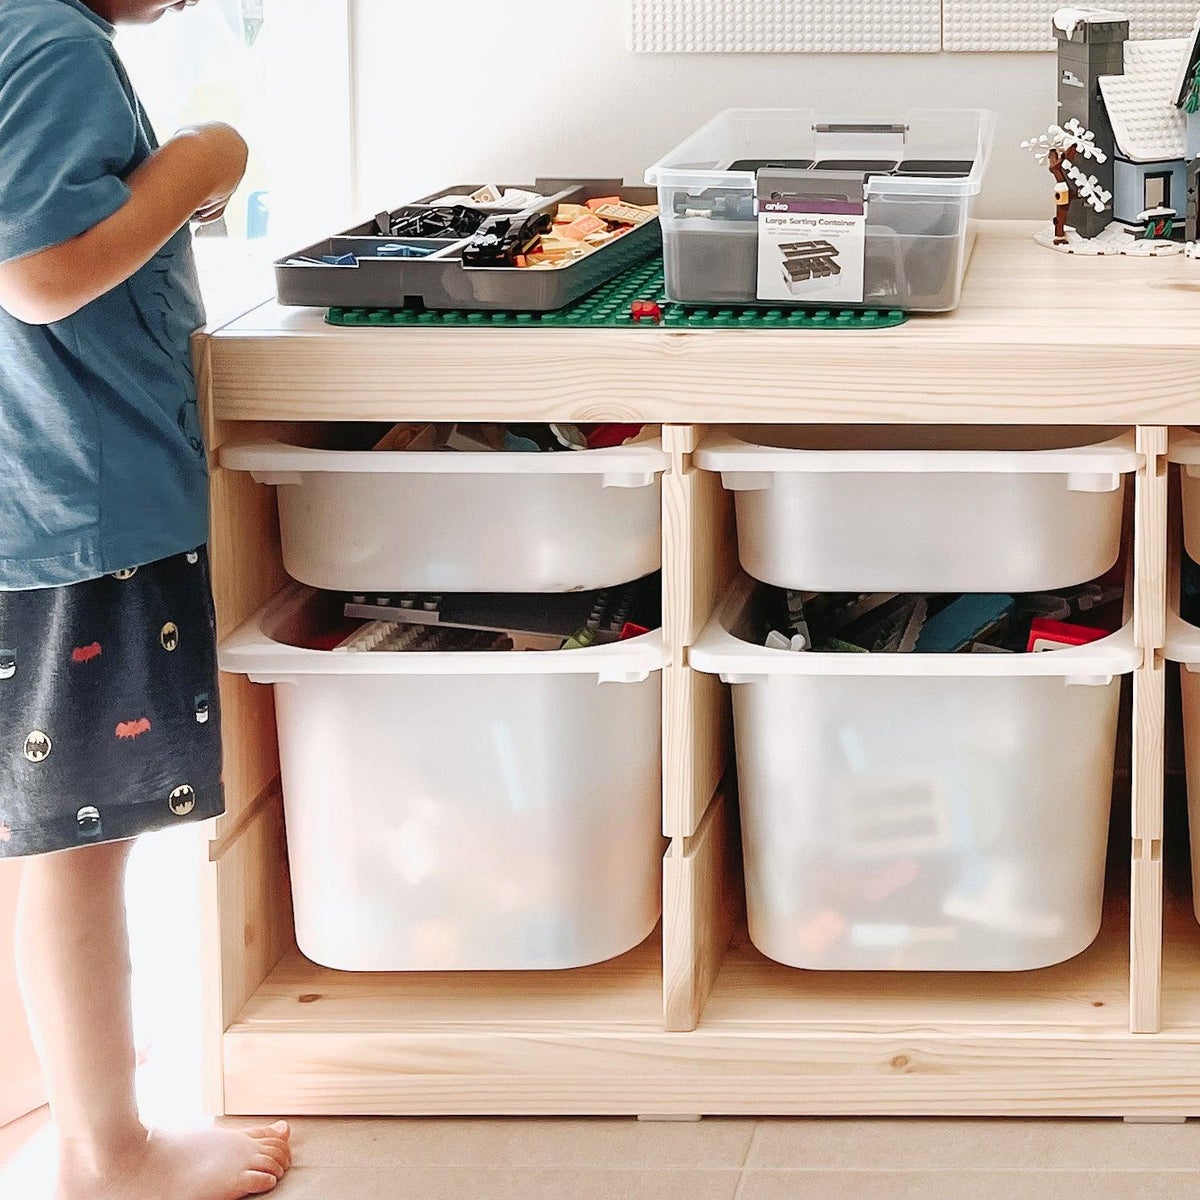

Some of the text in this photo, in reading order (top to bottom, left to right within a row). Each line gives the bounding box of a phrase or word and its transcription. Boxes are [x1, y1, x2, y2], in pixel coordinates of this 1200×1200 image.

[765, 202, 788, 211] anko
[765, 217, 856, 227] Large Sorting Container
